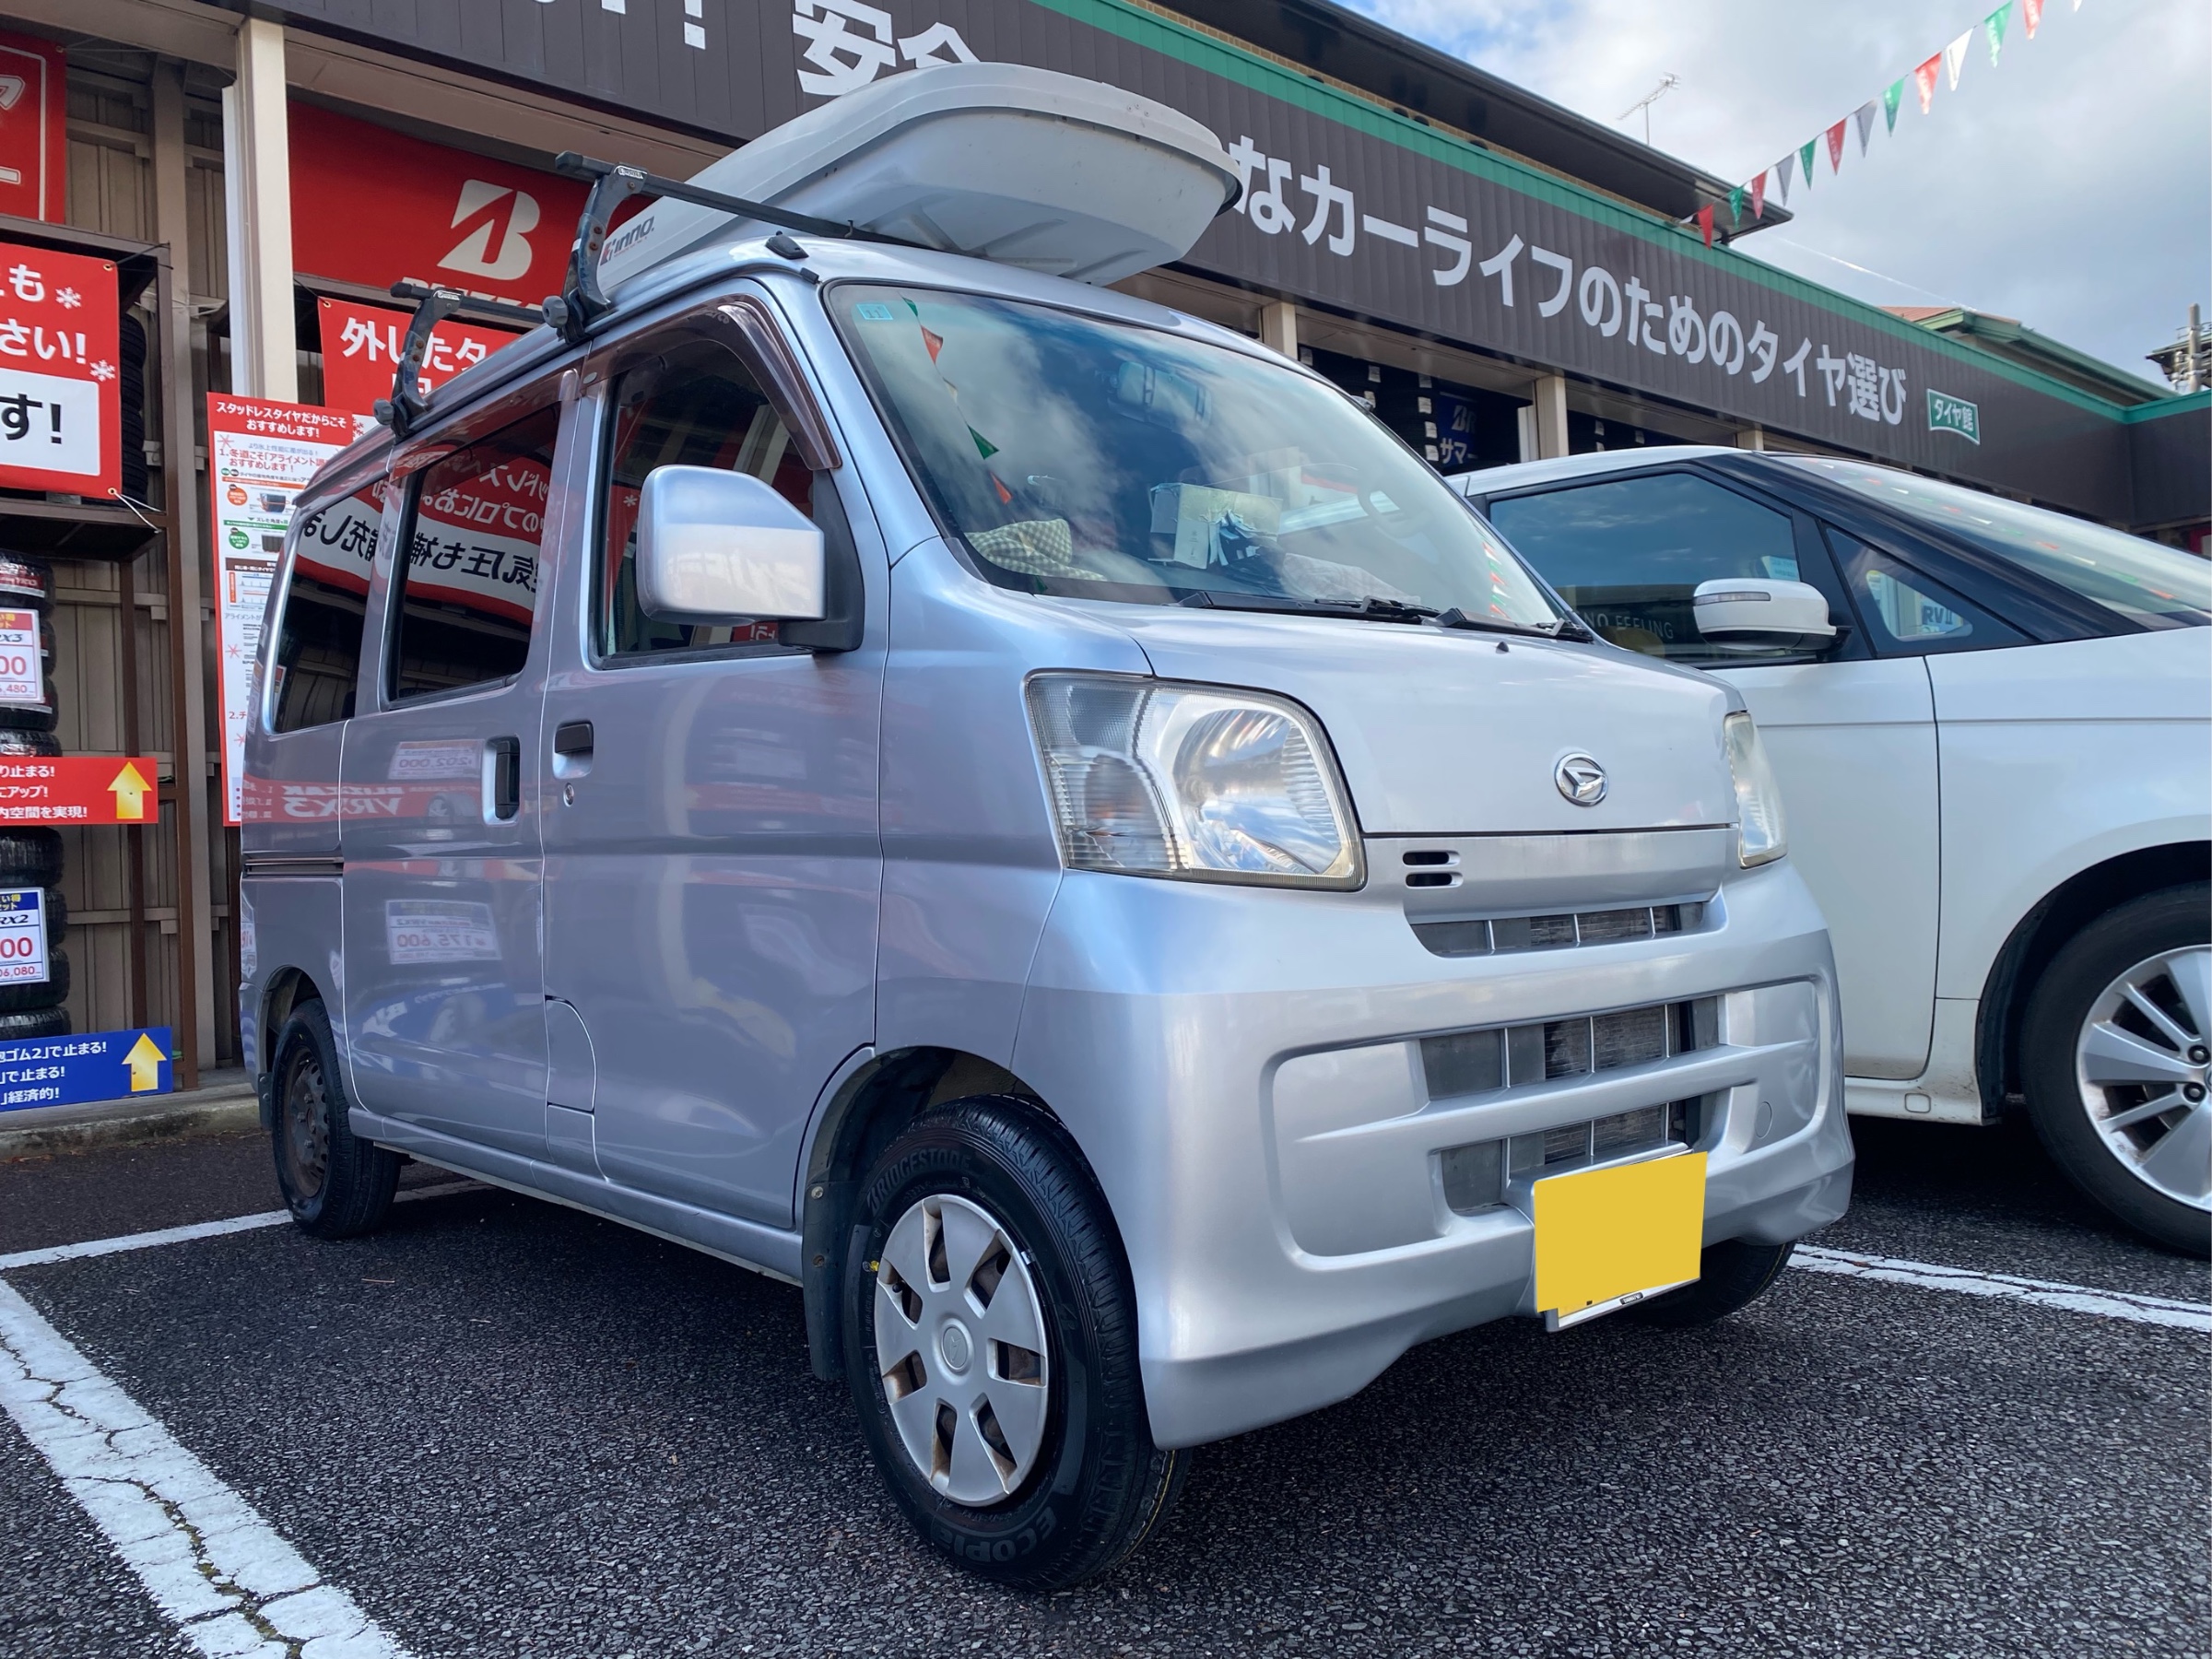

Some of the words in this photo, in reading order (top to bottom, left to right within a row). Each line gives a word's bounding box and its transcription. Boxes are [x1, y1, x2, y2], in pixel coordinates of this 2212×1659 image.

[0, 264, 45, 302] も
[1229, 135, 1907, 426] なカーライフのためのタイヤ選び
[217, 402, 347, 429] スタッドレスタイヤだからこそ
[246, 419, 320, 438] おすすめします!
[1934, 397, 1974, 432] タイヤ館
